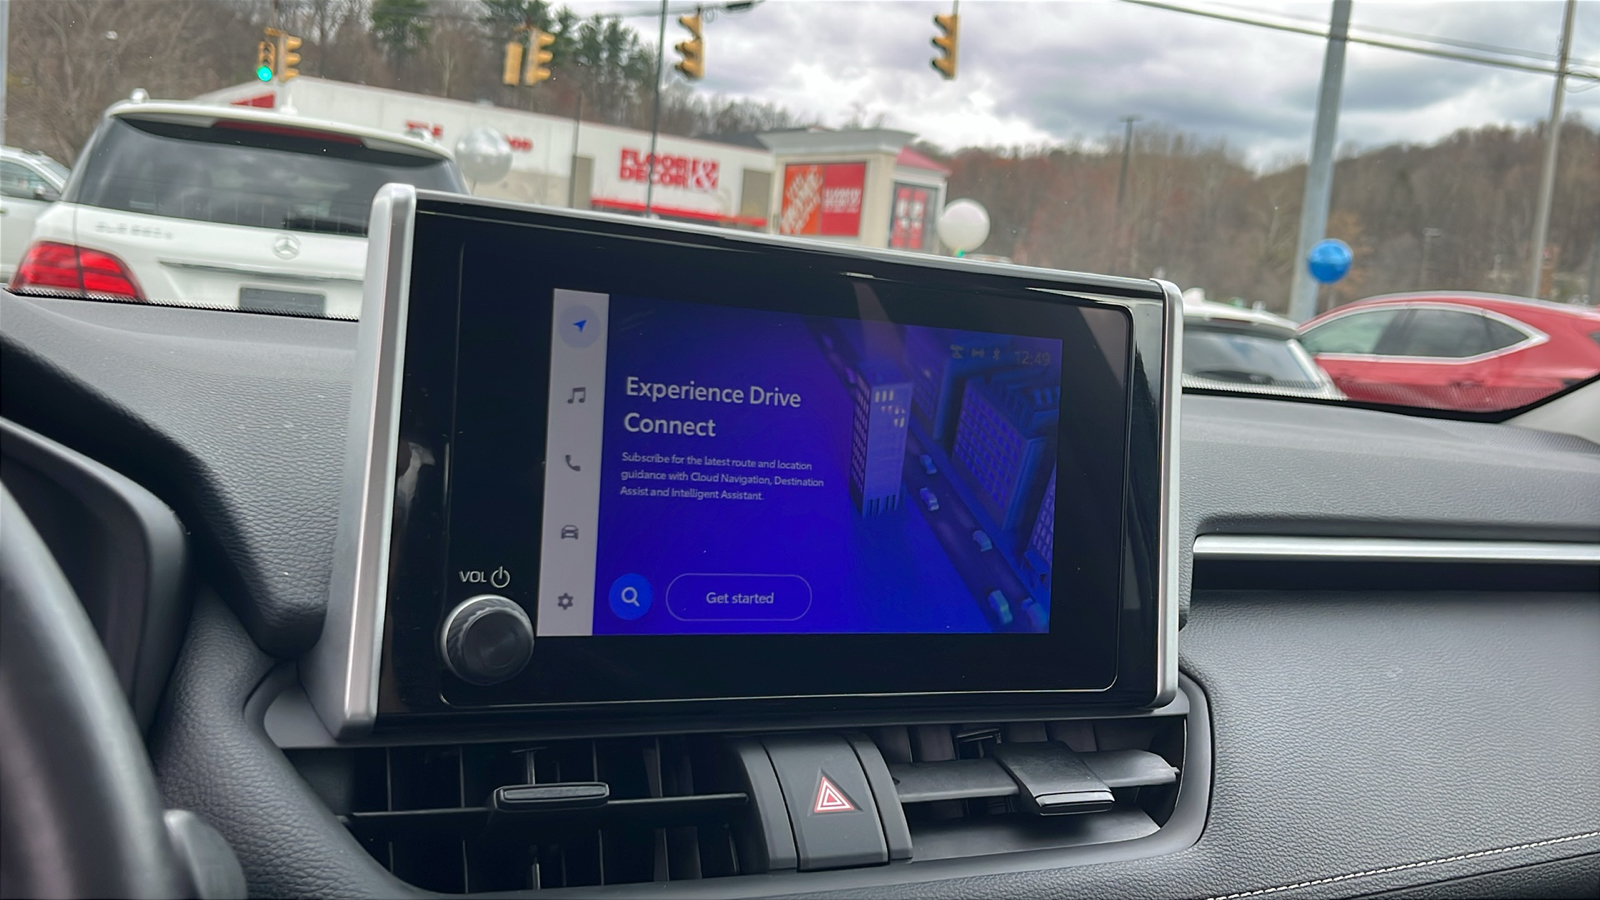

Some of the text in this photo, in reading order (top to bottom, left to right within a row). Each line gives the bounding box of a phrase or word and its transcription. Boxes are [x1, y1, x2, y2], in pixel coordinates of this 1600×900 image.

[1014, 350, 1052, 367] 12:49
[626, 376, 802, 408] Experience Drive
[623, 412, 717, 437] Connect
[621, 451, 813, 471] Subscribe for the latest route and location
[620, 469, 825, 487] guidance with Cloud Navigation, Destination
[619, 486, 765, 501] Assist and Intelligent Assistant.
[458, 570, 488, 583] VOL
[706, 591, 775, 605] Get started
